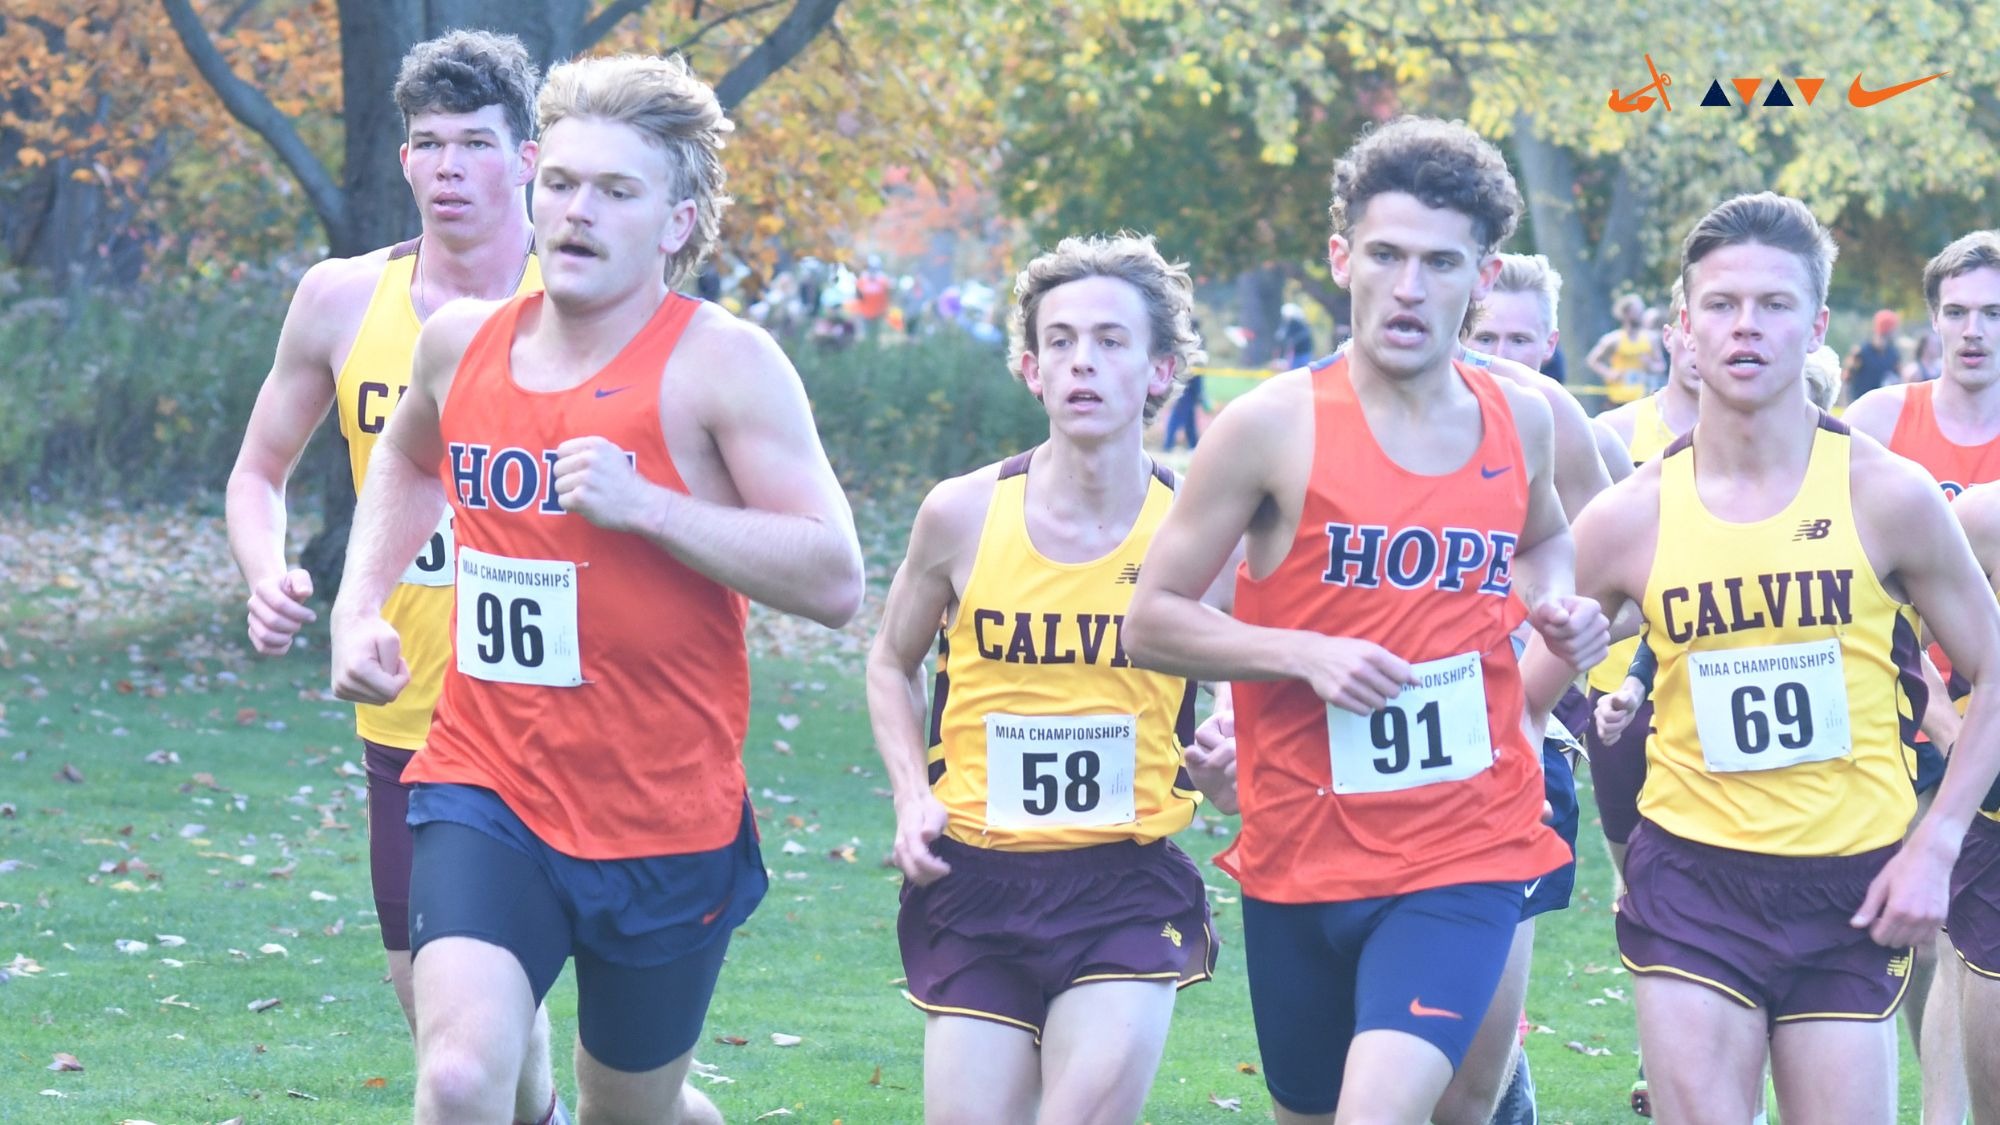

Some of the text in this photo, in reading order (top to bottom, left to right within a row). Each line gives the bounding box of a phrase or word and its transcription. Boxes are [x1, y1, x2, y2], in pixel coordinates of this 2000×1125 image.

[463, 558, 570, 588] MIAA CHAMPIONSHIPS
[1322, 522, 1518, 598] HOPE
[476, 592, 544, 667] 96
[1662, 569, 1853, 644] CALVIN
[1699, 651, 1835, 677] MIAA CHAMPIONSHIPS
[995, 725, 1130, 741] MIAA CHAMPIONSHIPS
[1370, 700, 1452, 774] 91
[1730, 681, 1814, 754] 69
[1022, 750, 1101, 816] 58
